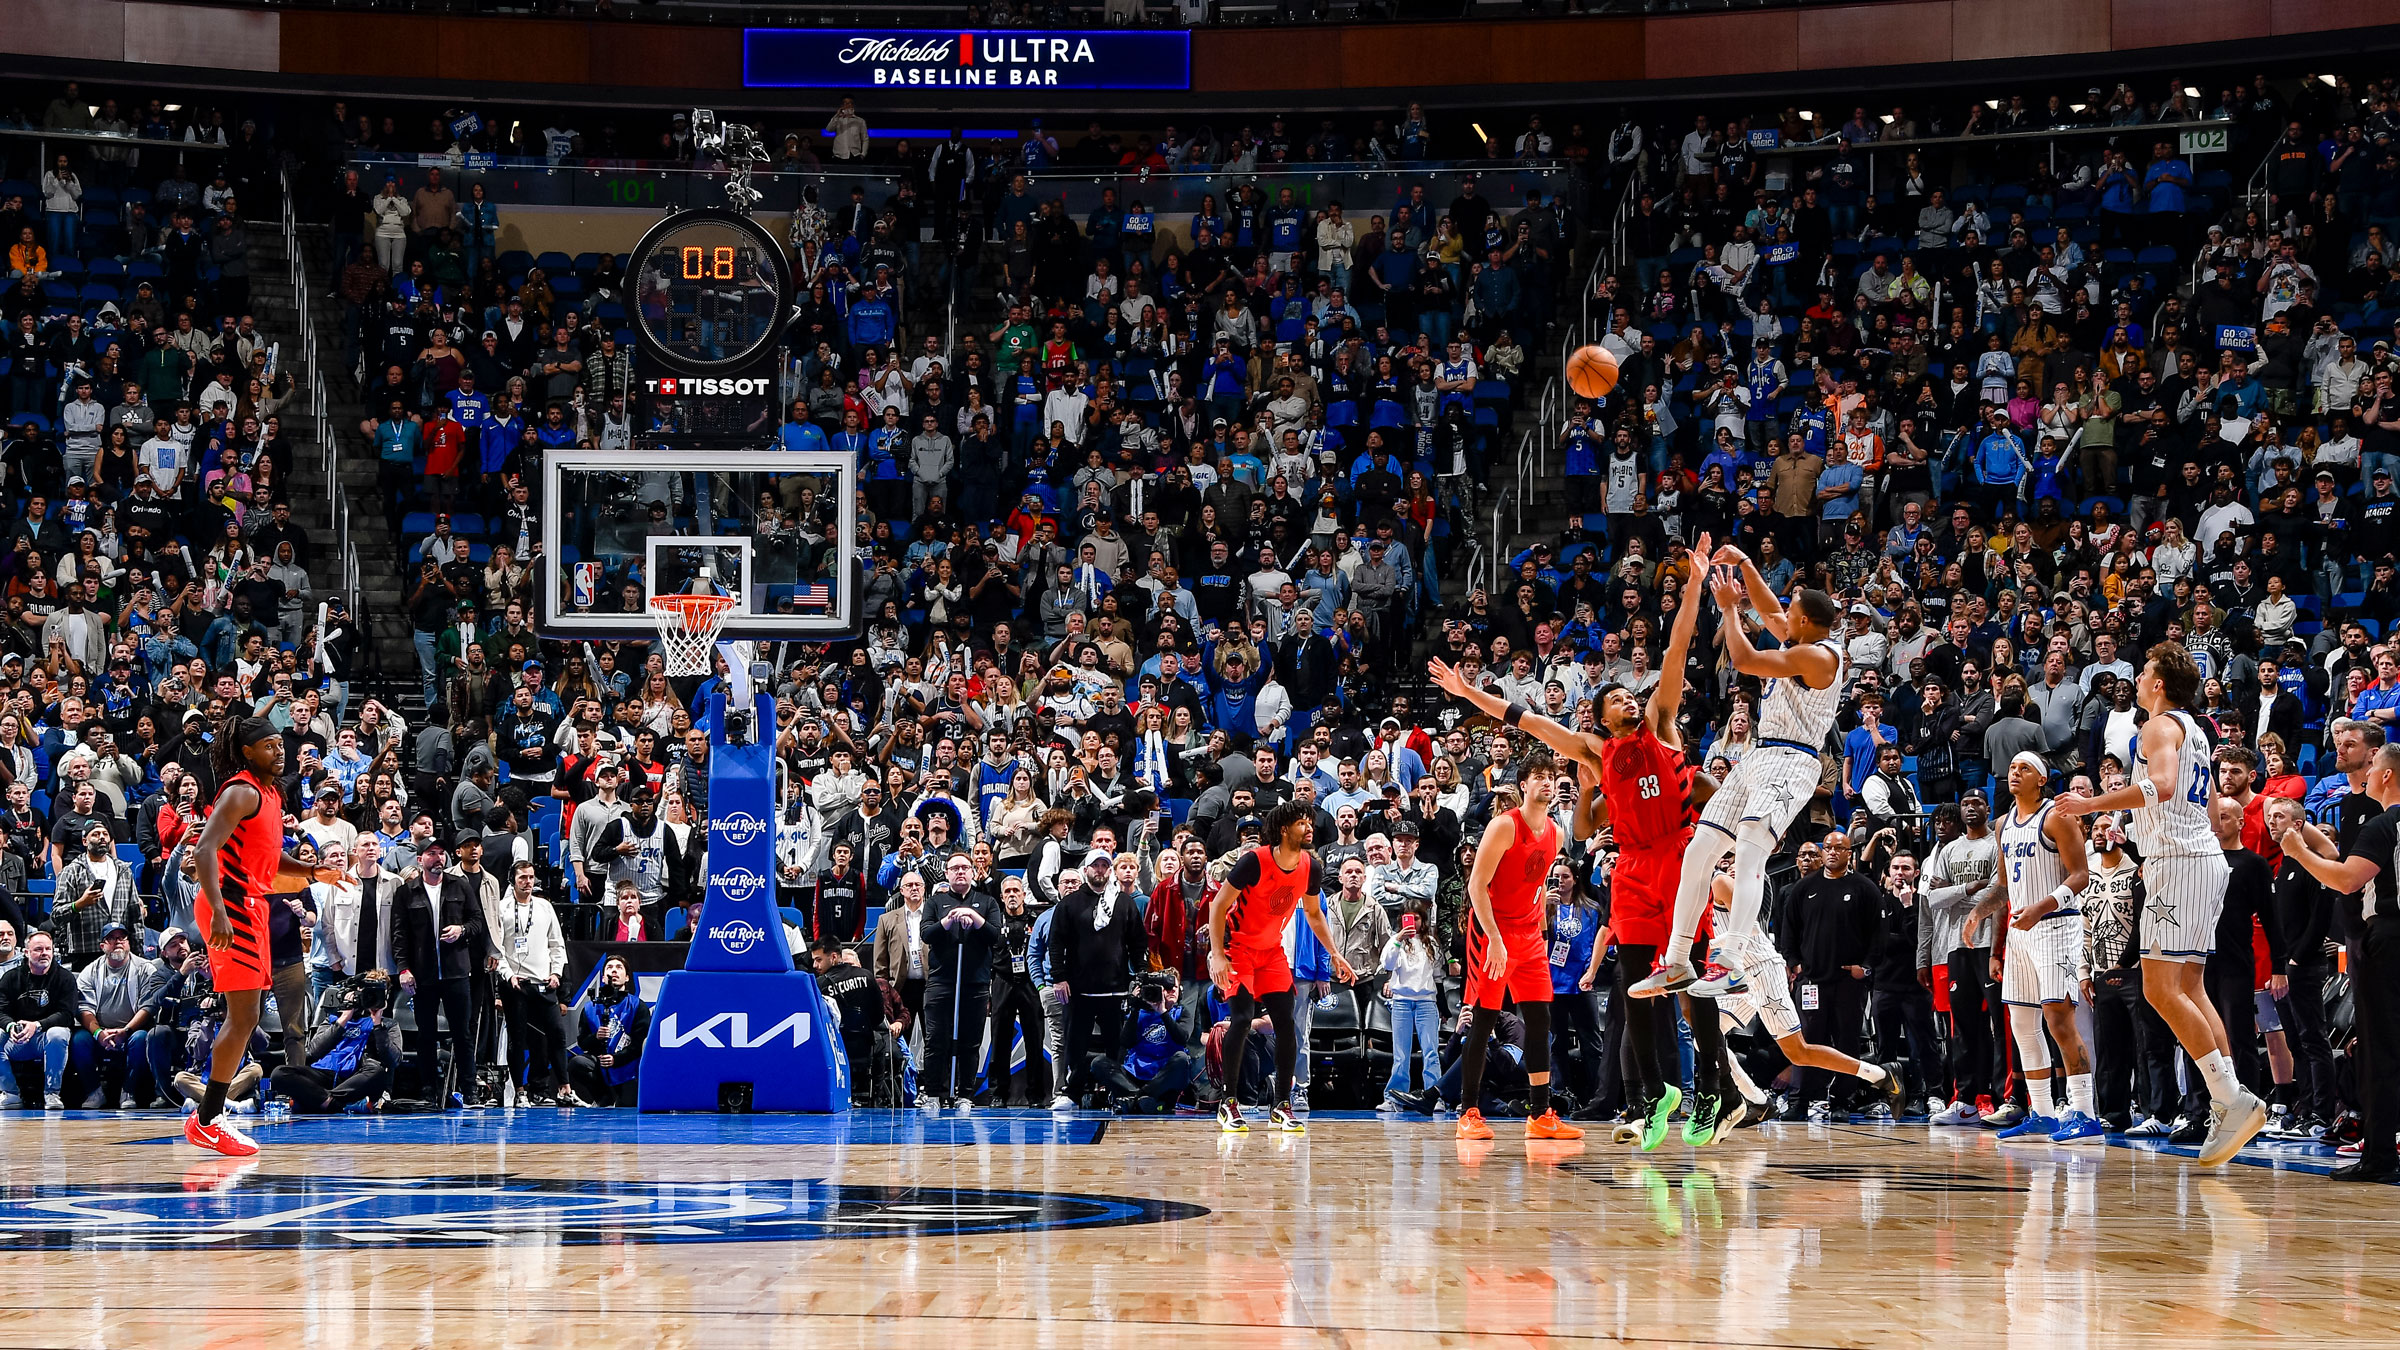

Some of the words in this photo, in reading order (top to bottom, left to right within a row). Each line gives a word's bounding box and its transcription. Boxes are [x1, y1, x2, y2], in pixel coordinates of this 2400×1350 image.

[838, 38, 954, 64] Michelob
[982, 38, 1095, 63] ULTRA
[873, 69, 997, 85] BASELINE
[1010, 69, 1059, 85] BAR
[1752, 132, 1762, 140] GO
[2184, 129, 2225, 149] 102
[1750, 139, 1775, 147] MAGIC!
[607, 179, 656, 203] 101
[1125, 222, 1150, 231] MAGIC!
[1242, 218, 1252, 228] 13
[1281, 226, 1290, 236] 15
[1772, 247, 1783, 256] GO
[682, 246, 735, 279] 0.8
[1770, 252, 1795, 263] MAGIC!
[2223, 328, 2236, 338] GO
[401, 335, 407, 346] 5
[2219, 337, 2250, 348] MAGIC!
[679, 379, 770, 396] TISSOT
[1755, 387, 1763, 400] 5
[462, 409, 475, 420] 22
[1805, 430, 1814, 440] 0
[1575, 440, 1583, 451] 5
[1754, 461, 1766, 470] GO
[1754, 469, 1771, 478] MAG
[1617, 476, 1625, 488] 5
[73, 505, 86, 514] GO
[2364, 507, 2393, 519] MAGIC
[577, 595, 587, 604] NBA
[944, 723, 964, 739] 22
[1638, 774, 1661, 800] 33
[2187, 762, 2209, 806] 22
[2143, 783, 2155, 797] 22
[712, 818, 737, 832] Hard
[738, 818, 767, 833] Rock
[732, 833, 748, 841] BET
[787, 847, 797, 865] 1
[638, 859, 648, 874] 5
[1973, 860, 1989, 873] FOR
[2013, 862, 2022, 882] 5
[709, 874, 736, 888] Hard
[737, 874, 766, 889] Rock
[731, 889, 745, 897] BET
[823, 888, 854, 898] ORLANDO
[2063, 894, 2071, 904] 5
[835, 904, 842, 918] 5
[709, 927, 736, 941] Hard
[737, 927, 766, 943] Rock
[730, 942, 745, 950] BET
[659, 1012, 811, 1048] KIA
